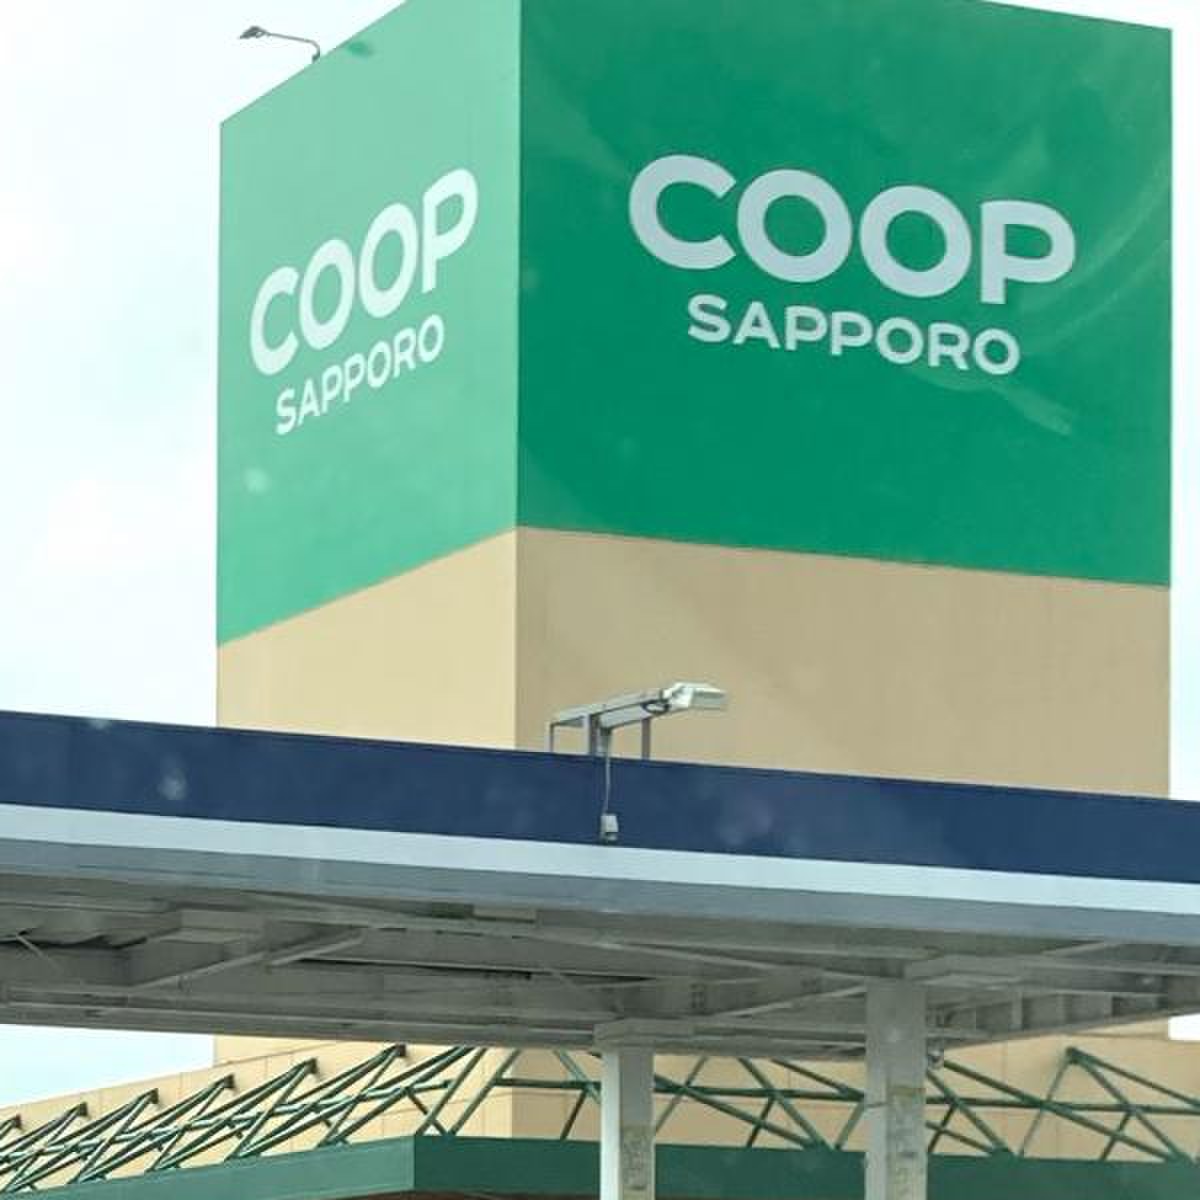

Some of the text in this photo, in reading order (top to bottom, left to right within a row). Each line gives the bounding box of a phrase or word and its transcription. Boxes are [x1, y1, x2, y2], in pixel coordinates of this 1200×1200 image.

[250, 167, 479, 376] COOP
[629, 154, 1076, 305] COOP
[275, 313, 445, 435] SAPPORO
[687, 292, 1021, 376] SAPPORO
